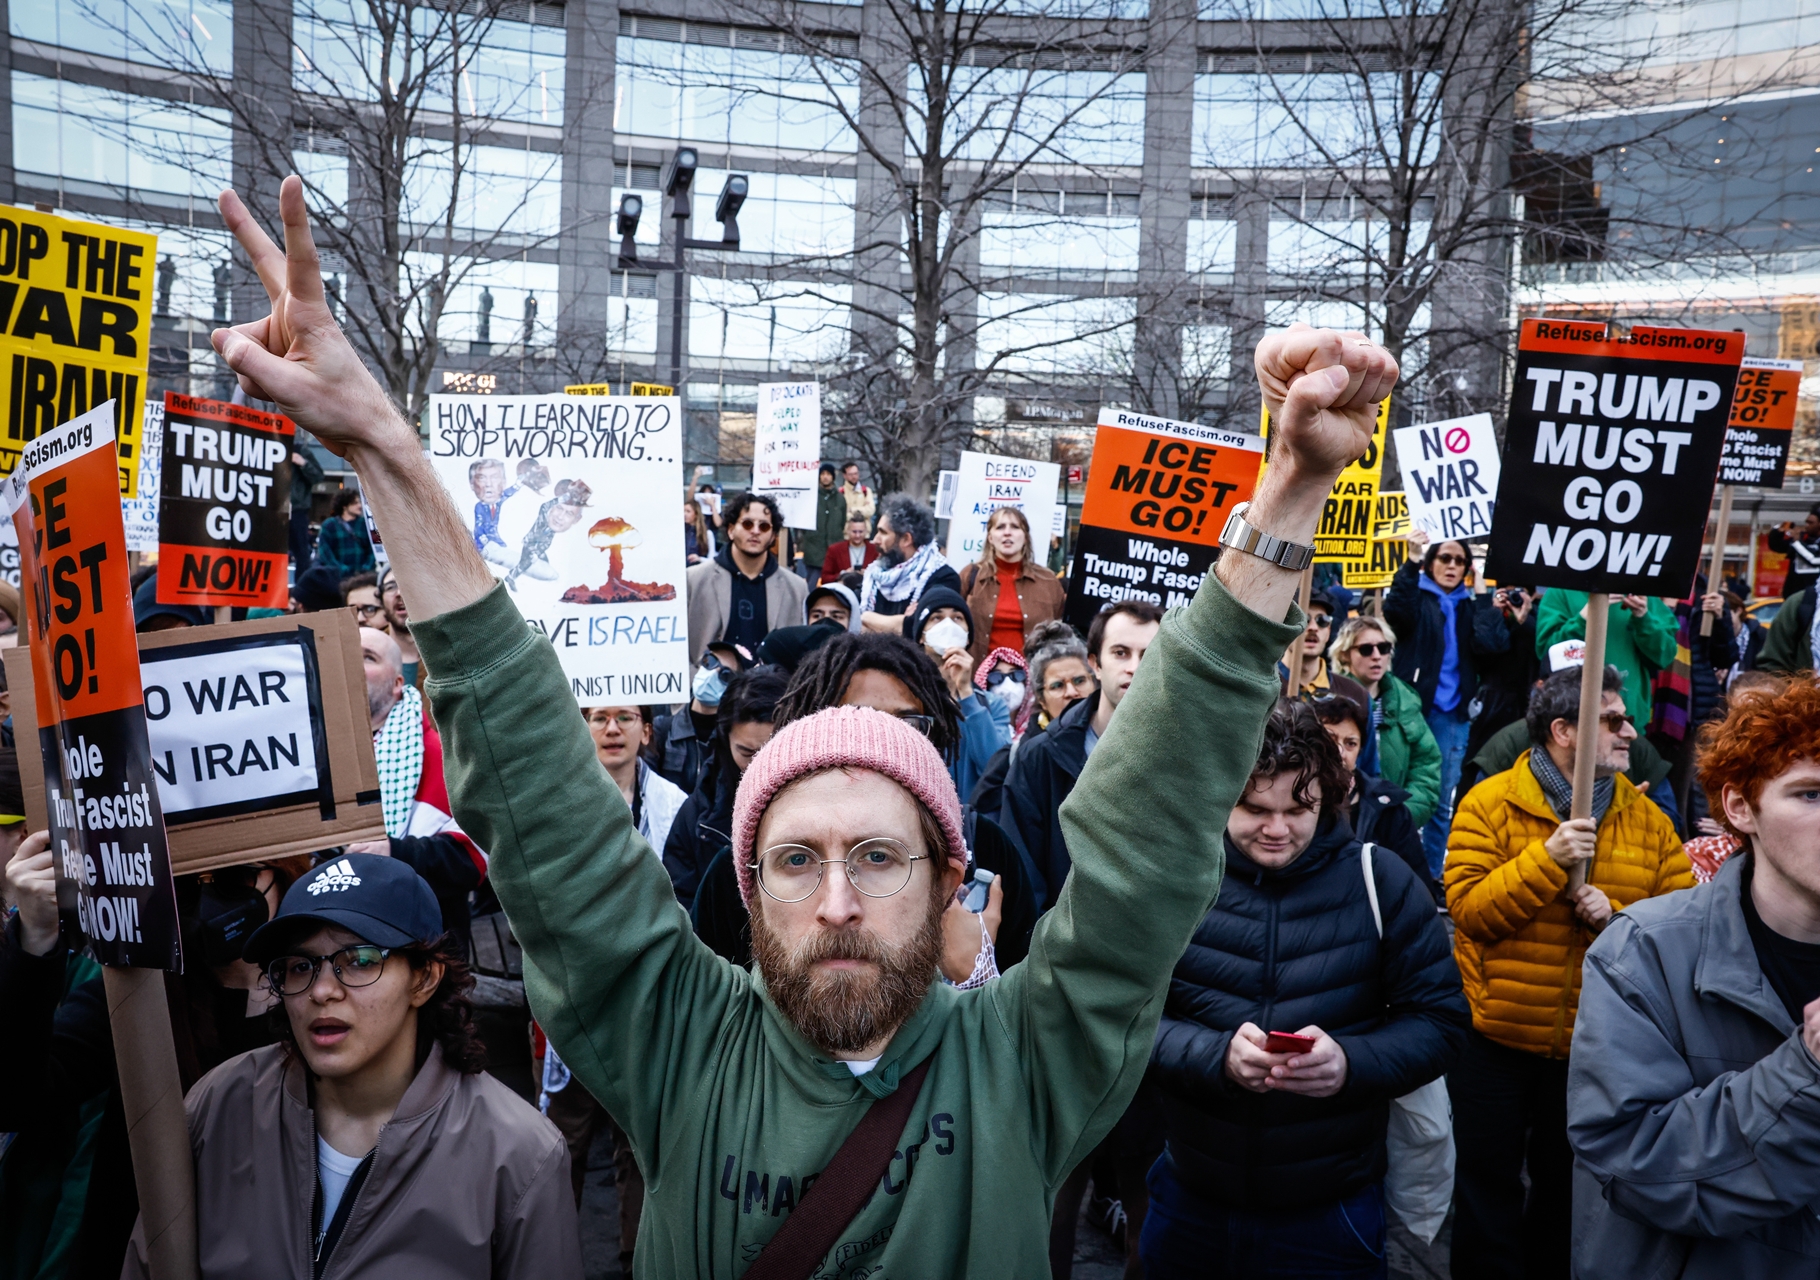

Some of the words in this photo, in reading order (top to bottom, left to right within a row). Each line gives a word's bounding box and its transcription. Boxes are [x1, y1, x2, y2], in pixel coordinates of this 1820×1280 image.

[0, 218, 49, 280] OP
[61, 230, 144, 301] THE
[0, 279, 139, 358] AR
[1526, 366, 1721, 424] TRUMP
[1734, 387, 1788, 406] UST
[1738, 370, 1774, 387] CE
[8, 353, 138, 459] IRAN!
[172, 394, 283, 430] RefuseFascism.org
[438, 403, 487, 431] HOW
[495, 404, 515, 431] I
[519, 403, 629, 432] LEARNED
[634, 404, 670, 432] TO
[434, 429, 499, 457] STOP
[780, 421, 799, 432] WAY
[1118, 414, 1245, 447] RefuseFascism.org
[170, 422, 287, 472] TRUMP
[1142, 439, 1217, 475] ICE
[1533, 421, 1692, 475] MUST
[1734, 442, 1783, 457] Fascist
[1743, 456, 1777, 470] Must
[181, 463, 273, 507] MUST
[985, 462, 1037, 479] DEFEND
[1110, 464, 1238, 508] MUST
[1410, 458, 1488, 504] WAR
[1723, 467, 1762, 483] NOW!
[989, 484, 1022, 498] IRAN
[1375, 496, 1409, 520] NDS
[1563, 475, 1643, 524] GO
[205, 506, 252, 543] GO
[1130, 500, 1208, 535] GO!
[1320, 498, 1371, 535] RAN
[1374, 519, 1409, 537] FF
[1128, 538, 1189, 567] Whole
[1522, 523, 1672, 577] NOW!
[179, 553, 272, 593] NOW!
[1083, 553, 1147, 584] Trump
[1083, 576, 1161, 607] Regime
[588, 616, 686, 646] ISRAEL
[54, 628, 99, 701] O!
[143, 685, 171, 721] O
[182, 670, 291, 715] WAR
[621, 672, 682, 695] UNION
[61, 735, 104, 780] hole
[152, 750, 177, 786] N
[190, 732, 300, 782] IRAN
[74, 782, 154, 831] Fascist
[99, 841, 154, 887] Must
[307, 873, 362, 893] adidas
[312, 884, 350, 897] GOLF
[85, 895, 143, 943] NOW!
